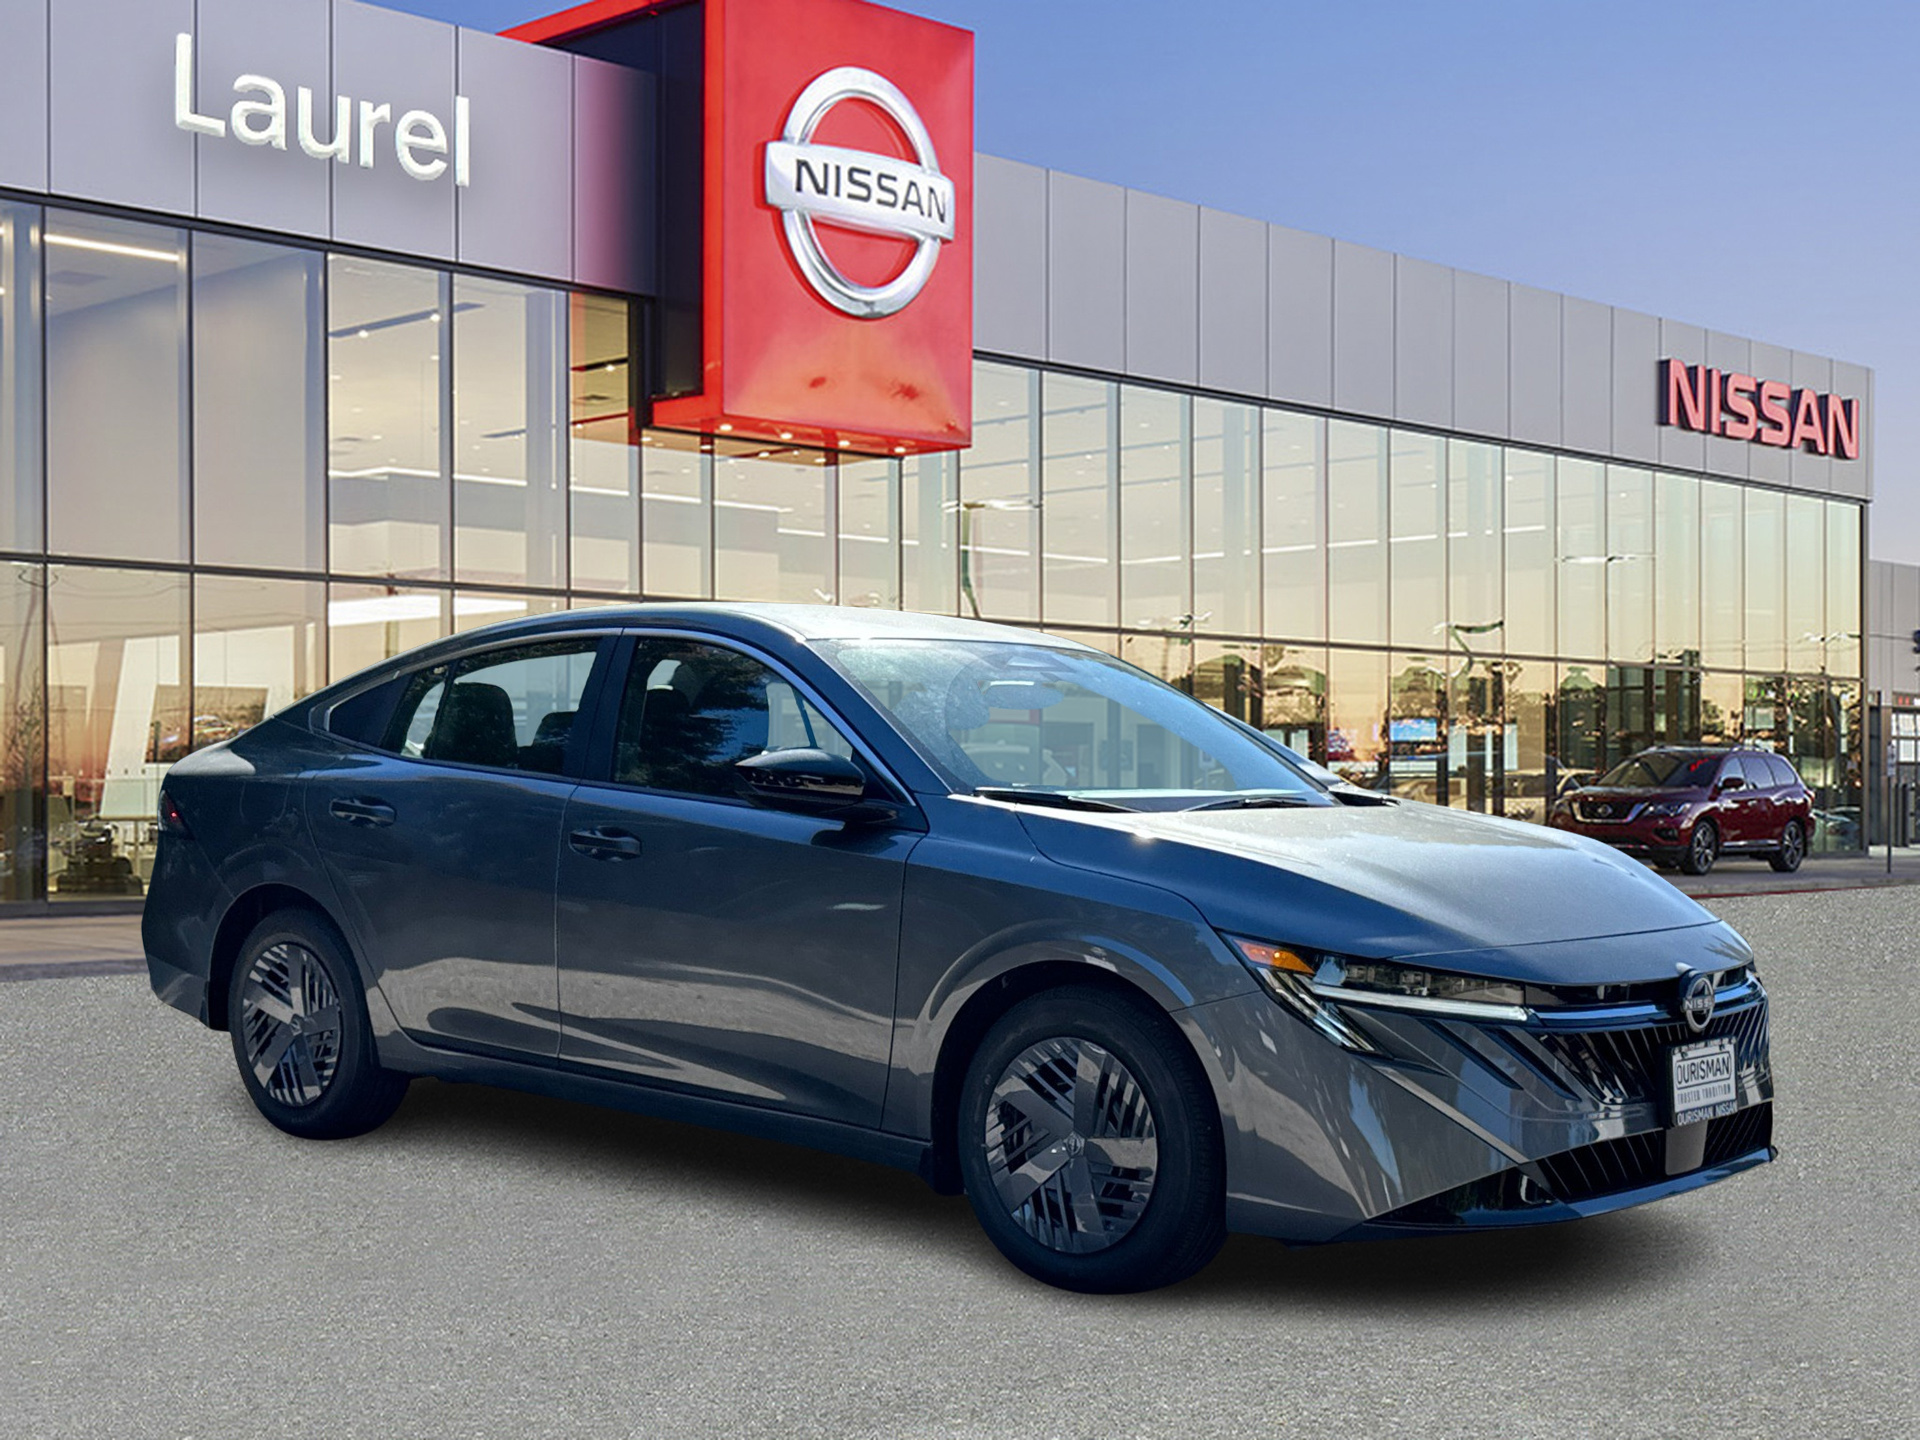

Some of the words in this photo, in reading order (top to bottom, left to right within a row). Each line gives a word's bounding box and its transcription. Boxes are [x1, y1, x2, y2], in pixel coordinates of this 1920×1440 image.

[175, 32, 470, 188] Laurel
[795, 158, 946, 224] NISSAN
[1660, 358, 1859, 460] NISSAN
[1676, 1056, 1730, 1085] OURISMAN
[1677, 1104, 1713, 1126] OURISMAN
[1715, 1099, 1738, 1117] NISSAN
